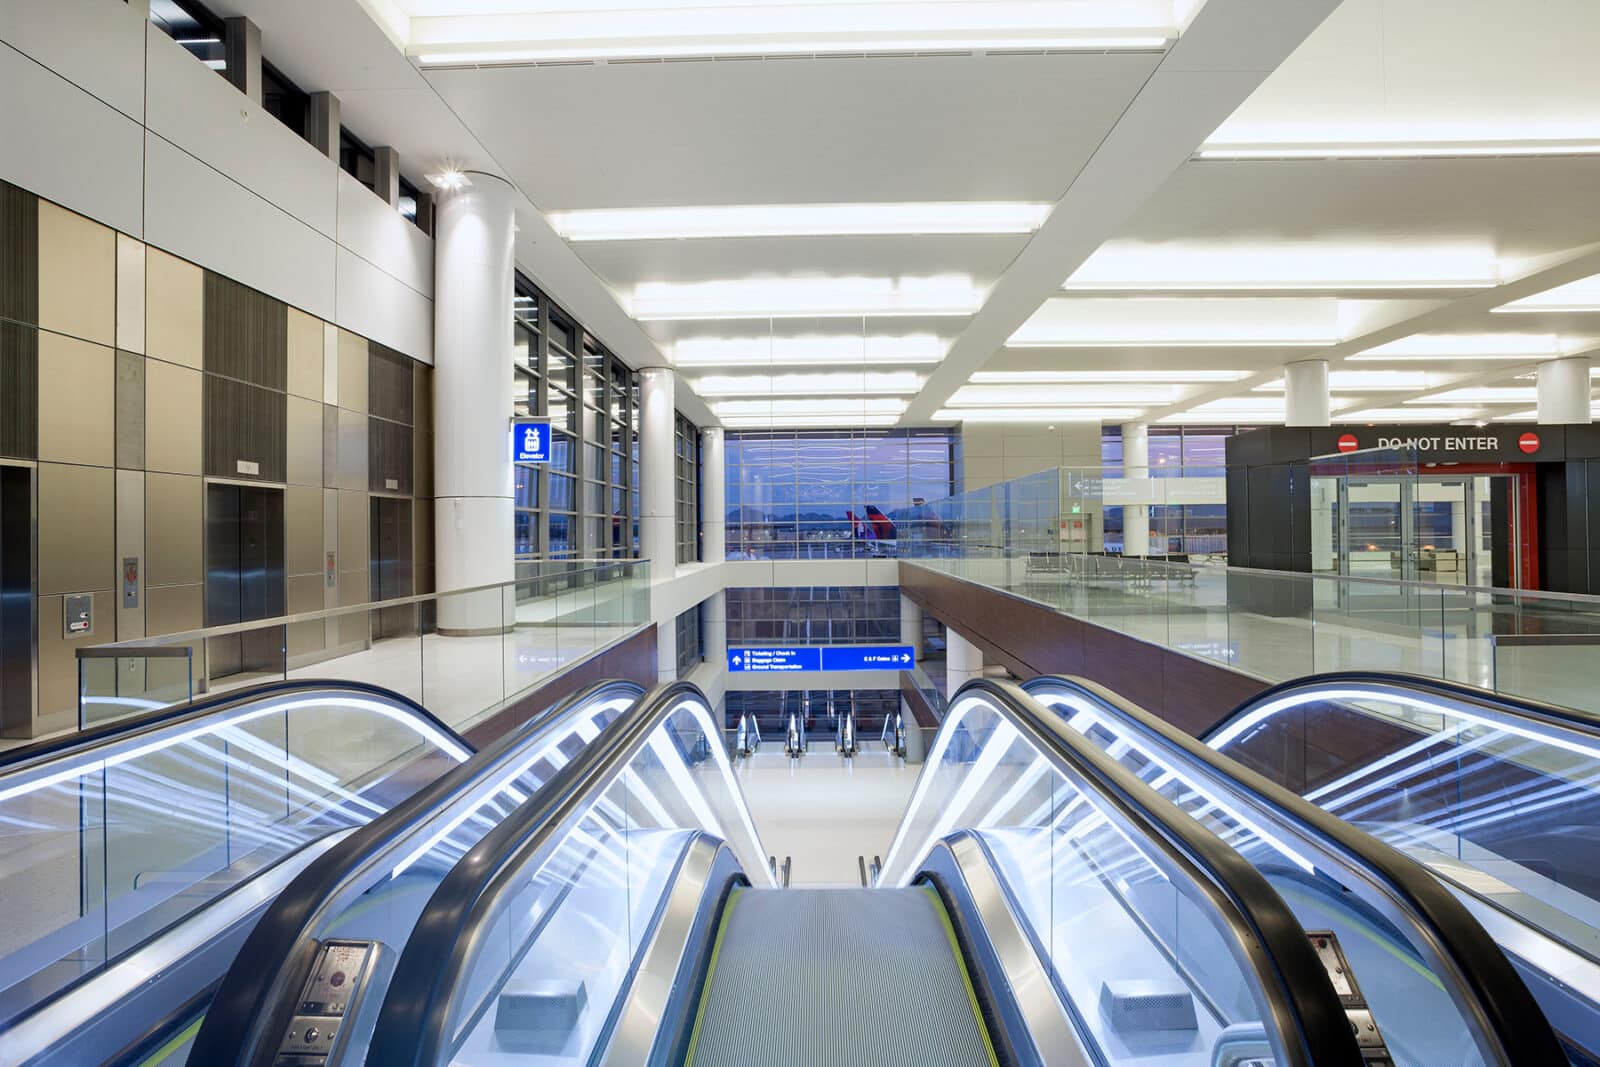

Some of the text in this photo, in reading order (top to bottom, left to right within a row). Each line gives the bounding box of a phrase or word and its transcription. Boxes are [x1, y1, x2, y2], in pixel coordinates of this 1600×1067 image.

[1377, 437, 1499, 450] DO NOT ENTER
